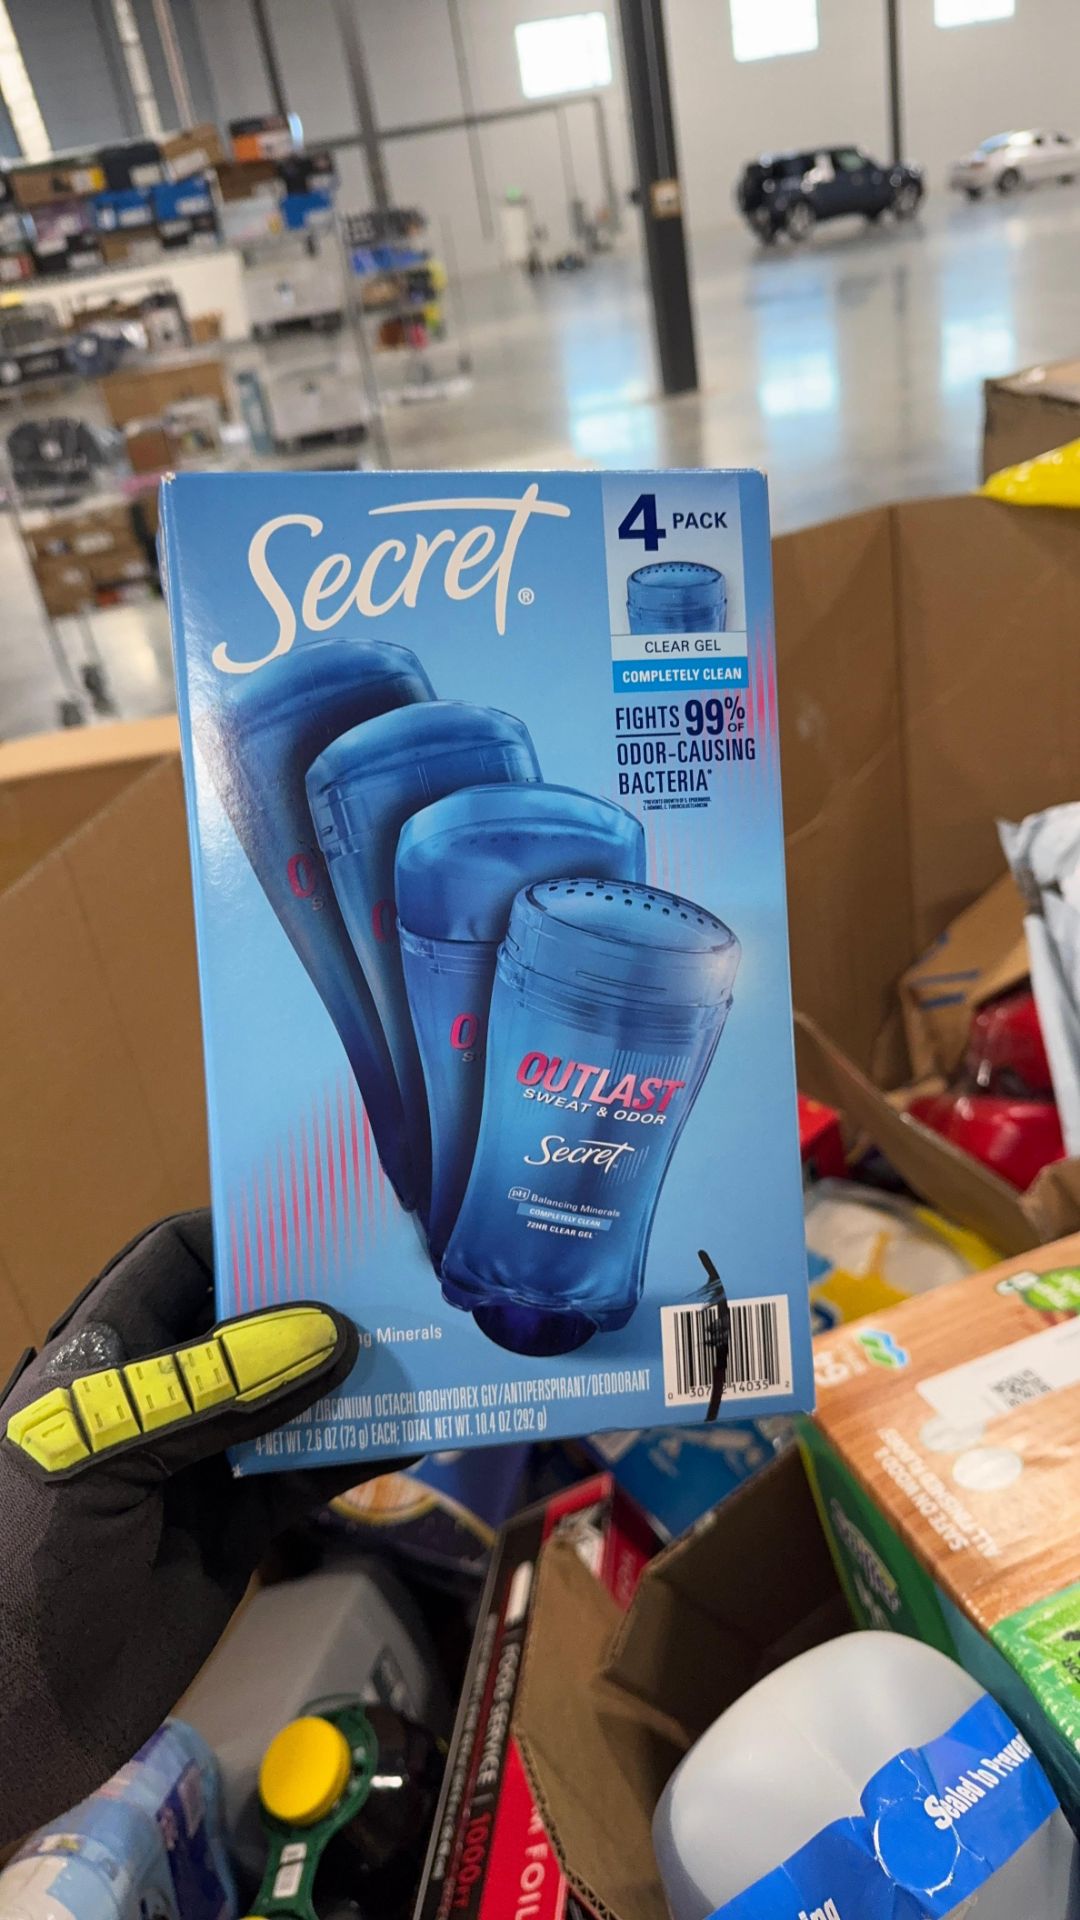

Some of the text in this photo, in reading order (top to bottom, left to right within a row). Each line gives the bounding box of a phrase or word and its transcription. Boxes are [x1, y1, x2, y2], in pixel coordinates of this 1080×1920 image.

[618, 493, 728, 551] 4 PACK
[212, 483, 571, 674] Secret
[644, 639, 721, 653] CLEAR GEL
[622, 667, 742, 683] COMPLETELY CLEAN
[615, 696, 745, 736] FIGHTS 99% OF
[617, 737, 756, 766] ODOR-CAUSING
[516, 1050, 686, 1114] OUTLAST
[523, 1088, 667, 1125] SWEAT & ODOR
[523, 1135, 635, 1174] Secret
[529, 1208, 601, 1227] COMPLETELY CLEAN
[531, 1193, 578, 1211] Balancing
[580, 1204, 620, 1218] Minerals
[526, 1220, 593, 1239] 72HR CLEAR GEL
[376, 1324, 442, 1344] Minerals
[315, 1395, 372, 1422] ZIRCONIUM
[374, 1386, 479, 1417] OCTACHLOROHYDREX
[668, 1392, 674, 1400] 0
[732, 1380, 769, 1393] 14035
[784, 1380, 790, 1388] 2
[286, 1429, 304, 1454] WT.
[306, 1428, 322, 1451] 2.6
[324, 1426, 338, 1449] OZ
[340, 1425, 356, 1450] (73
[358, 1422, 369, 1450] g)
[401, 1418, 432, 1443] TOTAL
[435, 1415, 452, 1439] NET
[454, 1414, 474, 1437] WT.
[475, 1411, 496, 1435] 10.4
[498, 1410, 512, 1432] OZ
[513, 1407, 535, 1432] (292
[537, 1405, 547, 1432] g)
[924, 1775, 986, 1830] Sealed
[966, 1768, 999, 1789] to
[514, 1842, 549, 1920] FOIL
